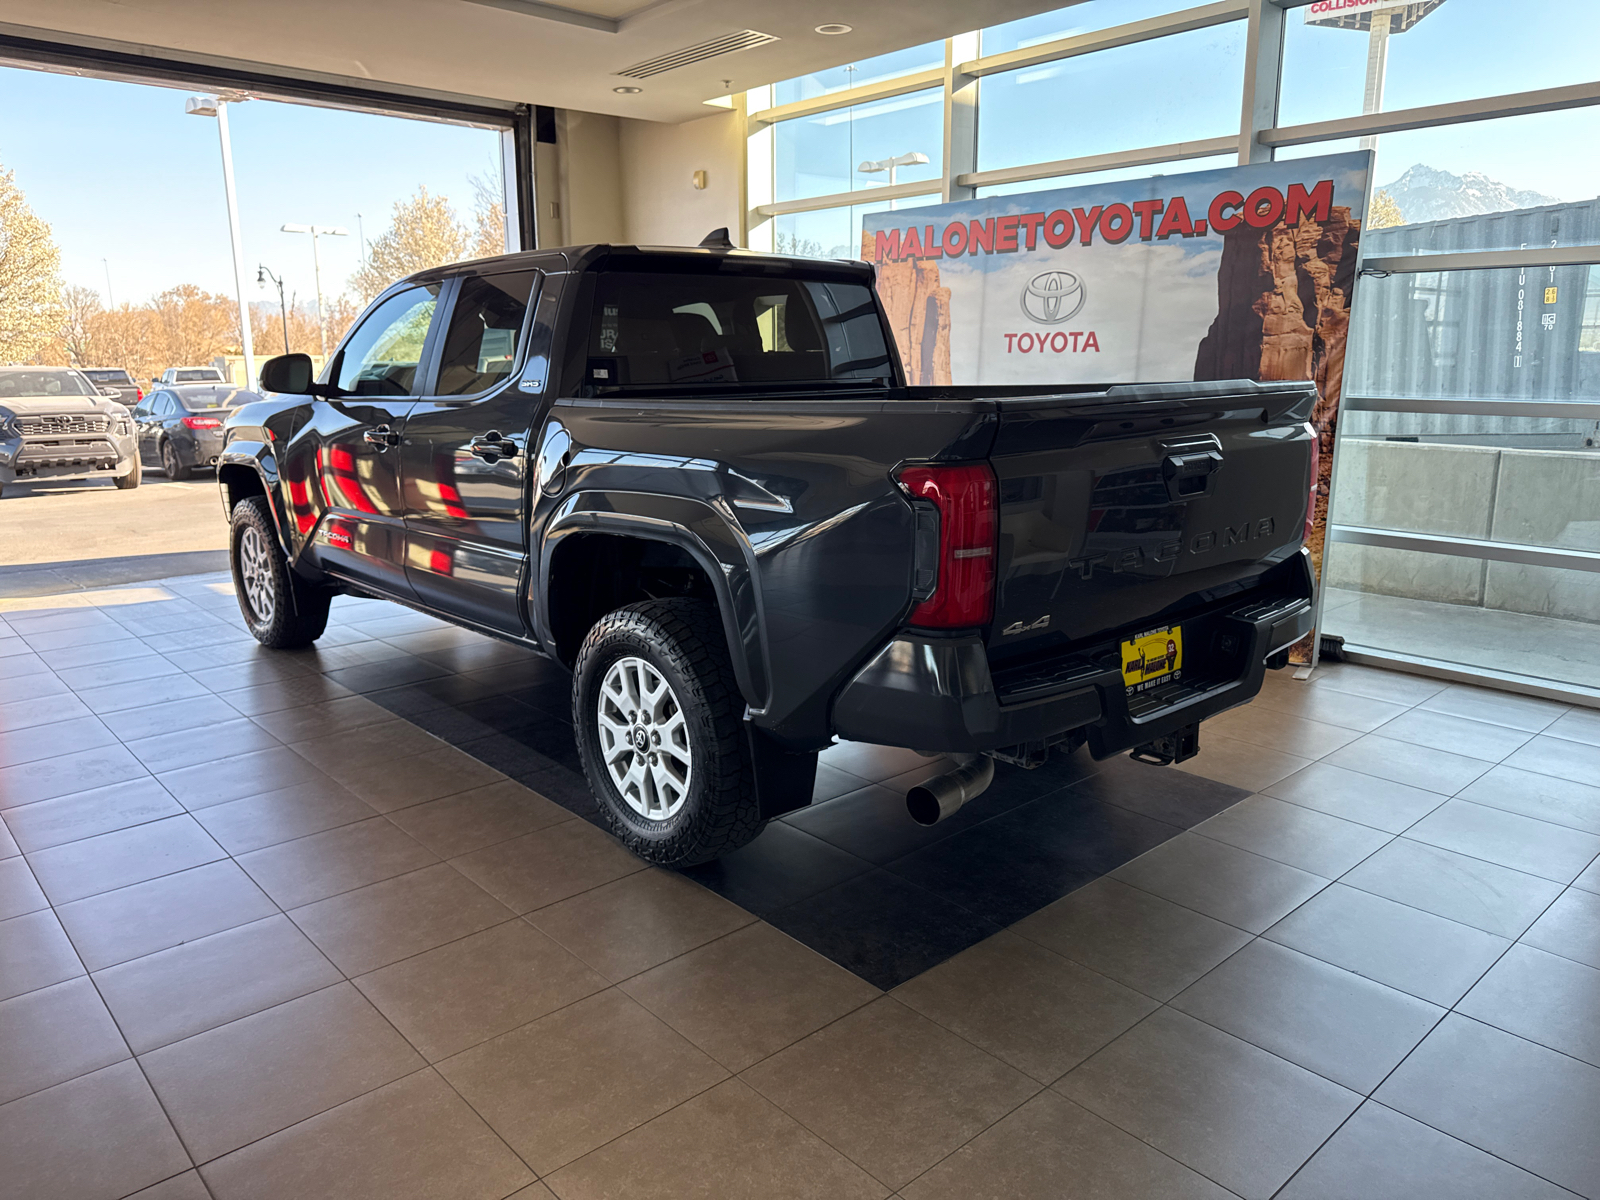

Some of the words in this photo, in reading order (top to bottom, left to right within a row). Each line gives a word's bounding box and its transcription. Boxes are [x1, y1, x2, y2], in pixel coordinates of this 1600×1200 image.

[875, 180, 1335, 263] MALONETOYOTA.COM
[1004, 331, 1100, 354] TOYOTA
[1068, 516, 1275, 580] TACOMA
[1167, 643, 1175, 652] 32
[1137, 683, 1144, 692] WE
[1145, 679, 1156, 689] MAKE
[1161, 674, 1172, 684] EASY
